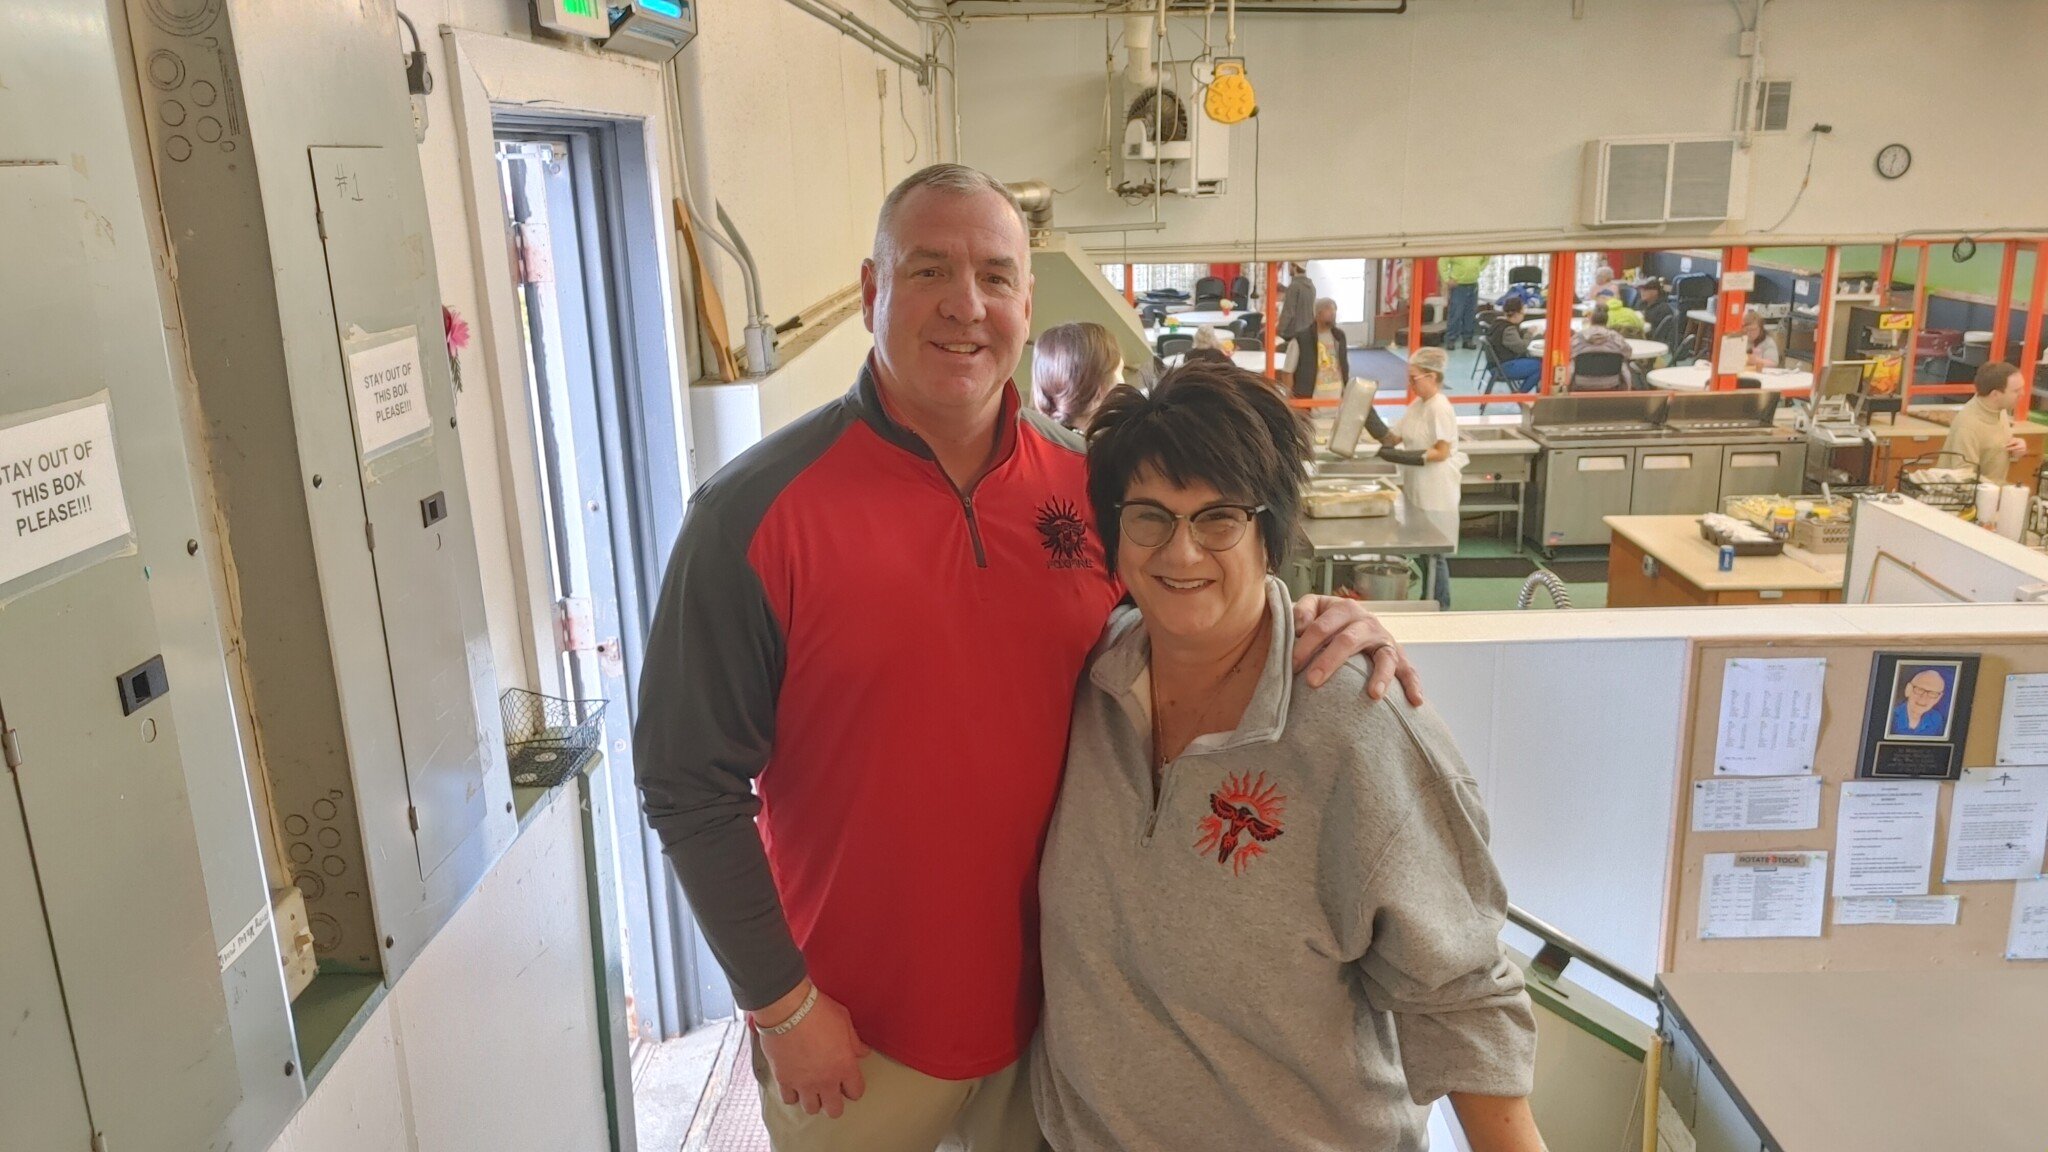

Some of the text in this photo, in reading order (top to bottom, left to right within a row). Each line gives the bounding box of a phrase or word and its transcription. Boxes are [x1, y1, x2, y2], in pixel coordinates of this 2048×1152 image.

[334, 163, 364, 202] #1
[363, 362, 412, 389] STAY OUT OF
[374, 382, 409, 404] THIS BOX
[375, 399, 412, 423] PLEASE!!!
[38, 447, 69, 472] OUT
[73, 440, 93, 460] OF
[12, 469, 86, 509] THIS BOX
[16, 494, 92, 537] PLEASE!!!
